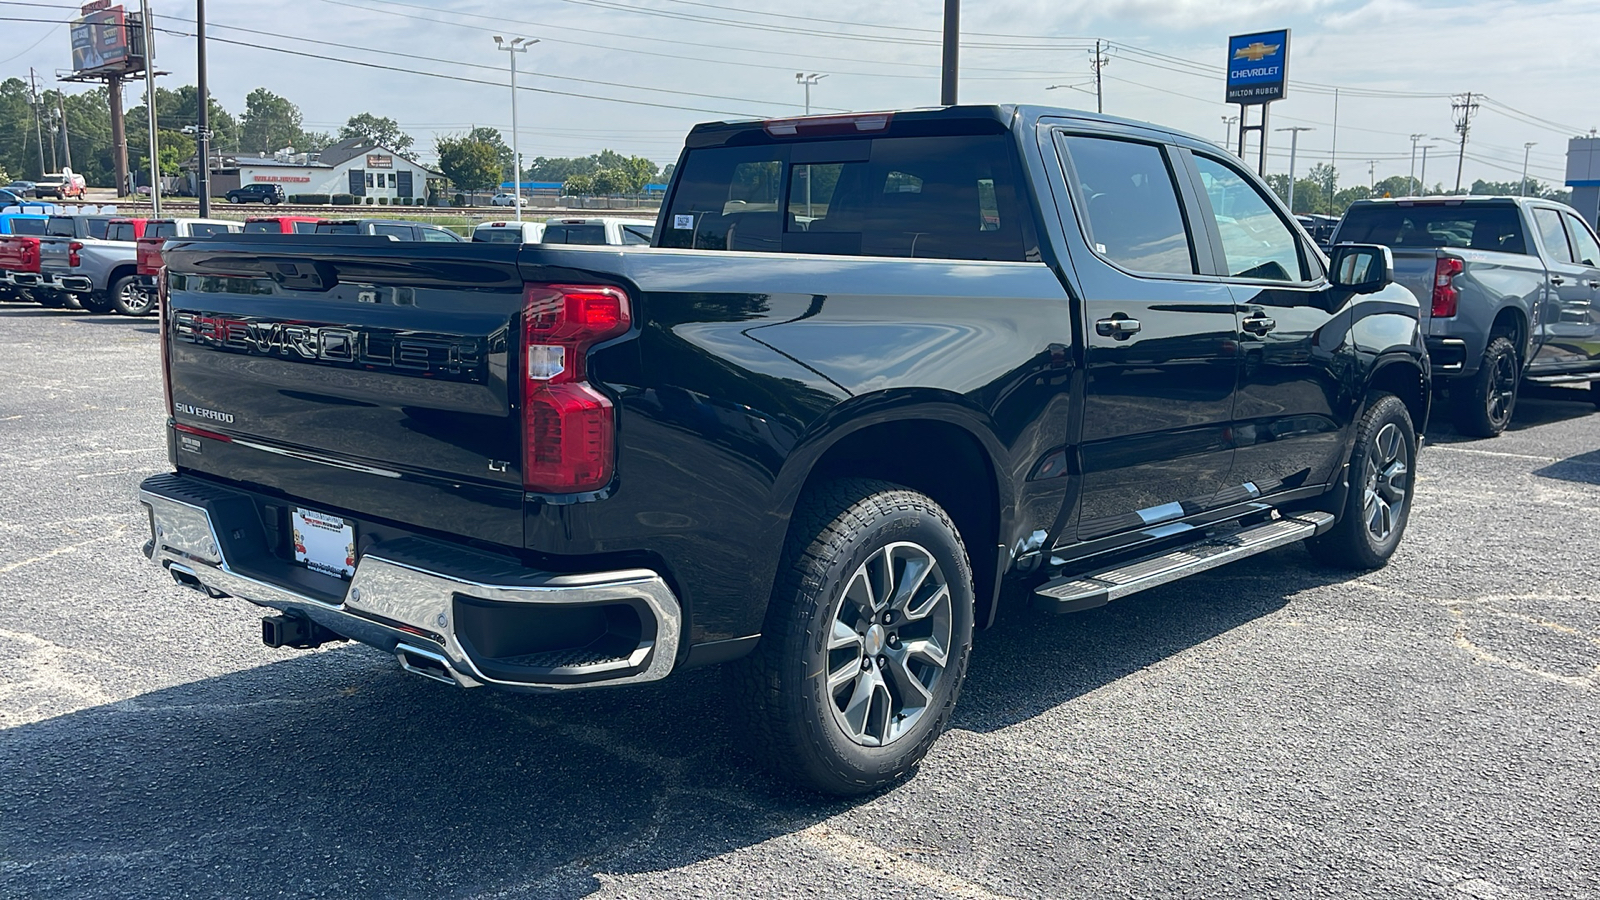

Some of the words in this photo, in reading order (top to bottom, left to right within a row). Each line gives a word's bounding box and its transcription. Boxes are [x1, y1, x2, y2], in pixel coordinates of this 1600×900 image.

[1231, 66, 1279, 79] CHEVROLET
[1229, 89, 1253, 98] MILTON
[1255, 86, 1279, 95] RUBEN
[175, 311, 480, 374] CHEVROLET
[175, 402, 234, 424] SILVERADO
[489, 459, 510, 473] LT
